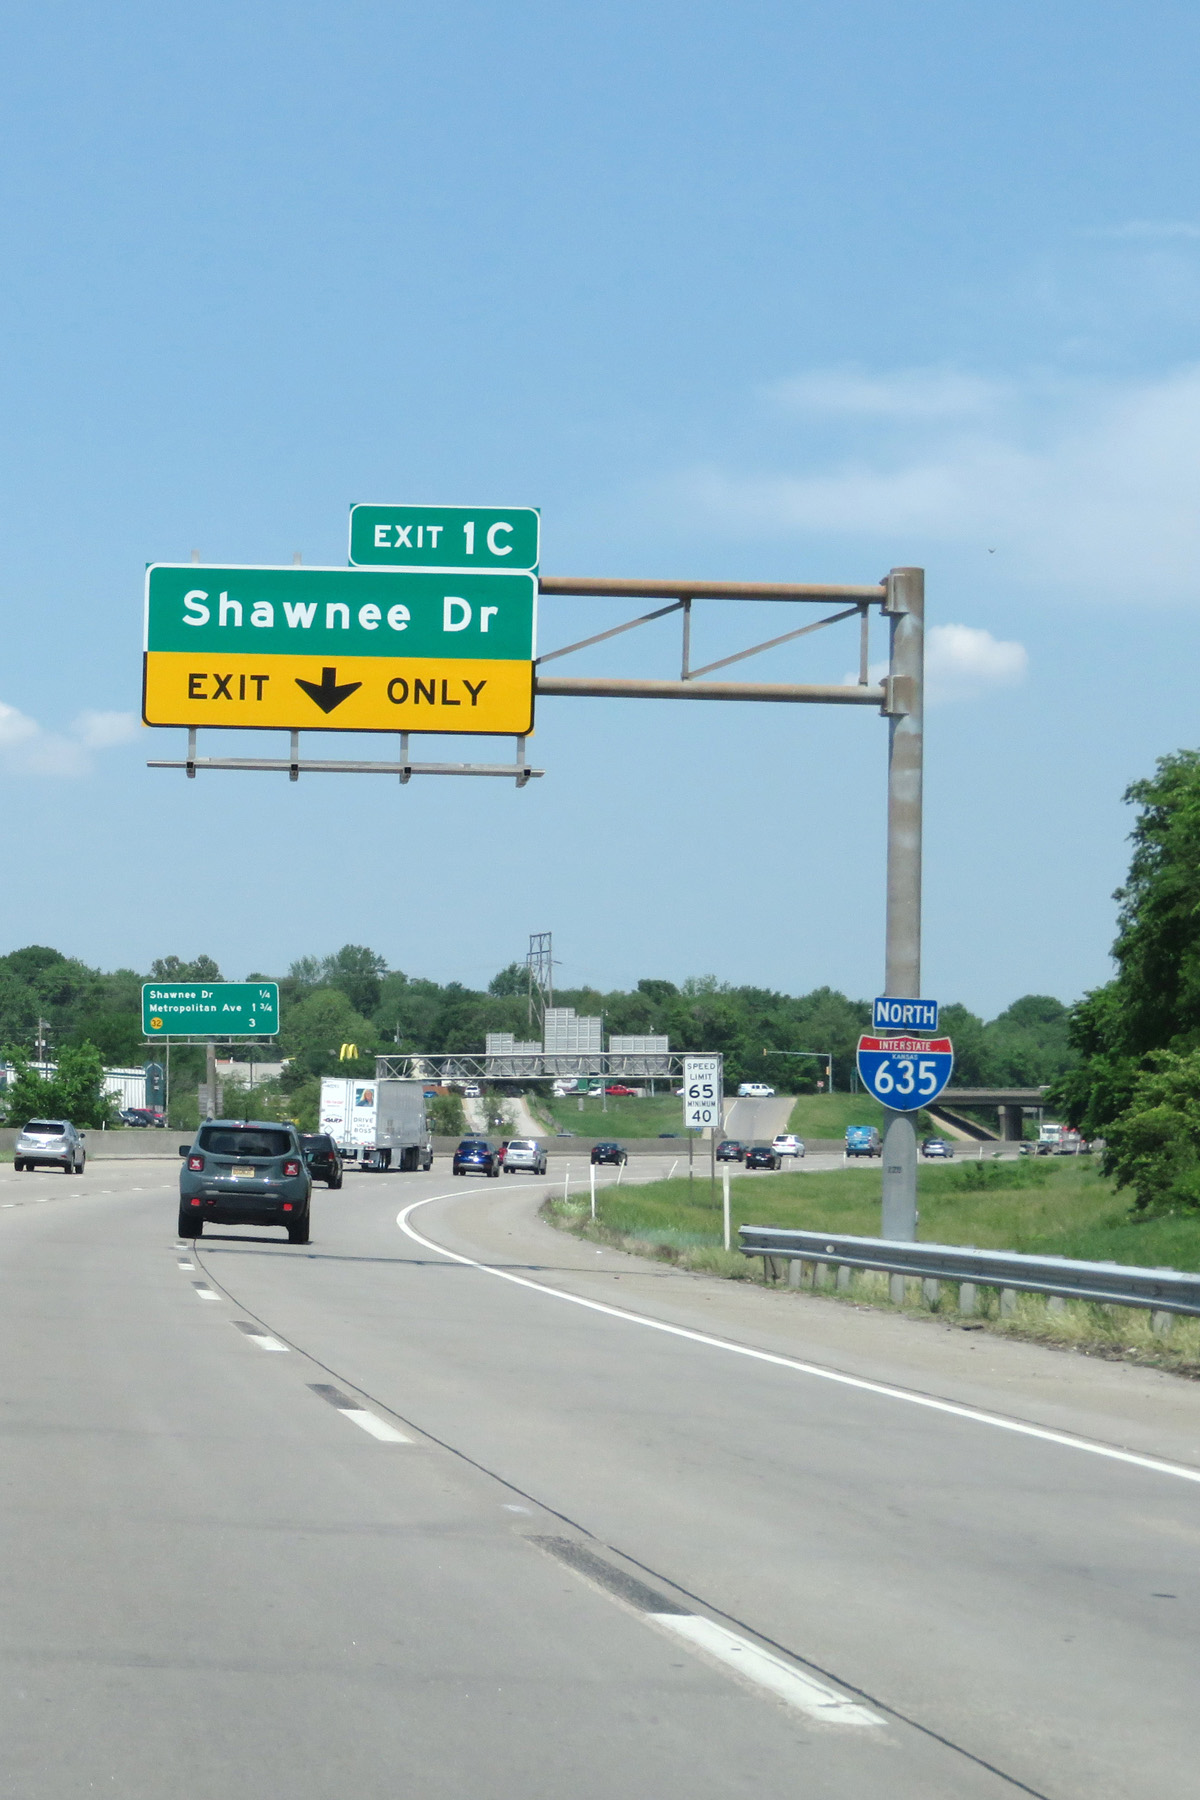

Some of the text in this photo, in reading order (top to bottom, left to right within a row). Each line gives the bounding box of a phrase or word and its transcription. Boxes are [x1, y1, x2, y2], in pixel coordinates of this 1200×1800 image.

[373, 521, 514, 557] EXIT 1C
[182, 589, 499, 633] Shawnee Dr
[187, 673, 488, 707] EXIT ONLY
[149, 990, 197, 999] Shawnee
[201, 990, 214, 999] Dr
[149, 1003, 217, 1014] Metropolitan
[222, 1003, 242, 1012] Ave
[877, 1002, 934, 1024] NORTH
[151, 1018, 256, 1027] 32 3
[879, 1040, 932, 1051] INTERSTATE
[874, 1060, 937, 1095] 635
[689, 1084, 713, 1098] 65
[692, 1110, 711, 1122] 40
